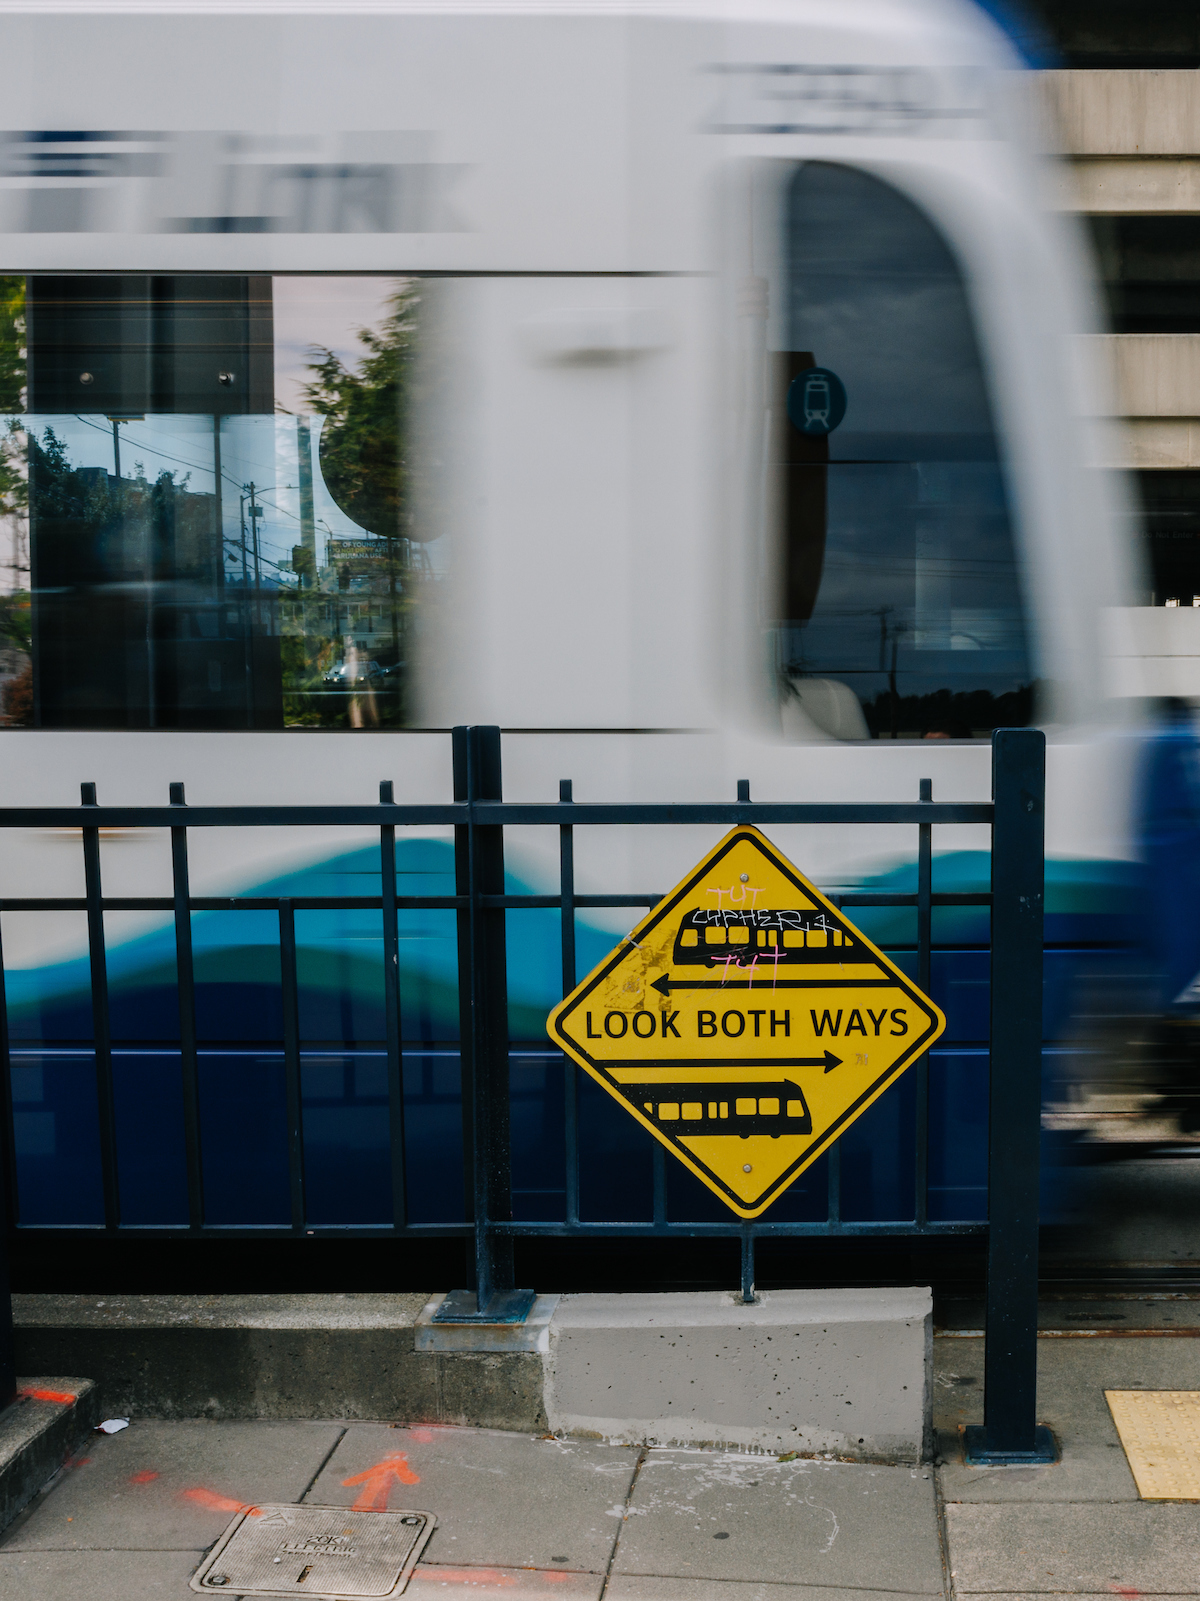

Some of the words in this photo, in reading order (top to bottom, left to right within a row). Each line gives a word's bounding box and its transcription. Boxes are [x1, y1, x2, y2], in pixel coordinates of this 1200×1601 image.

[586, 1011, 681, 1040] LOOK
[697, 1009, 791, 1038] BOTH
[809, 1008, 909, 1038] WAYS
